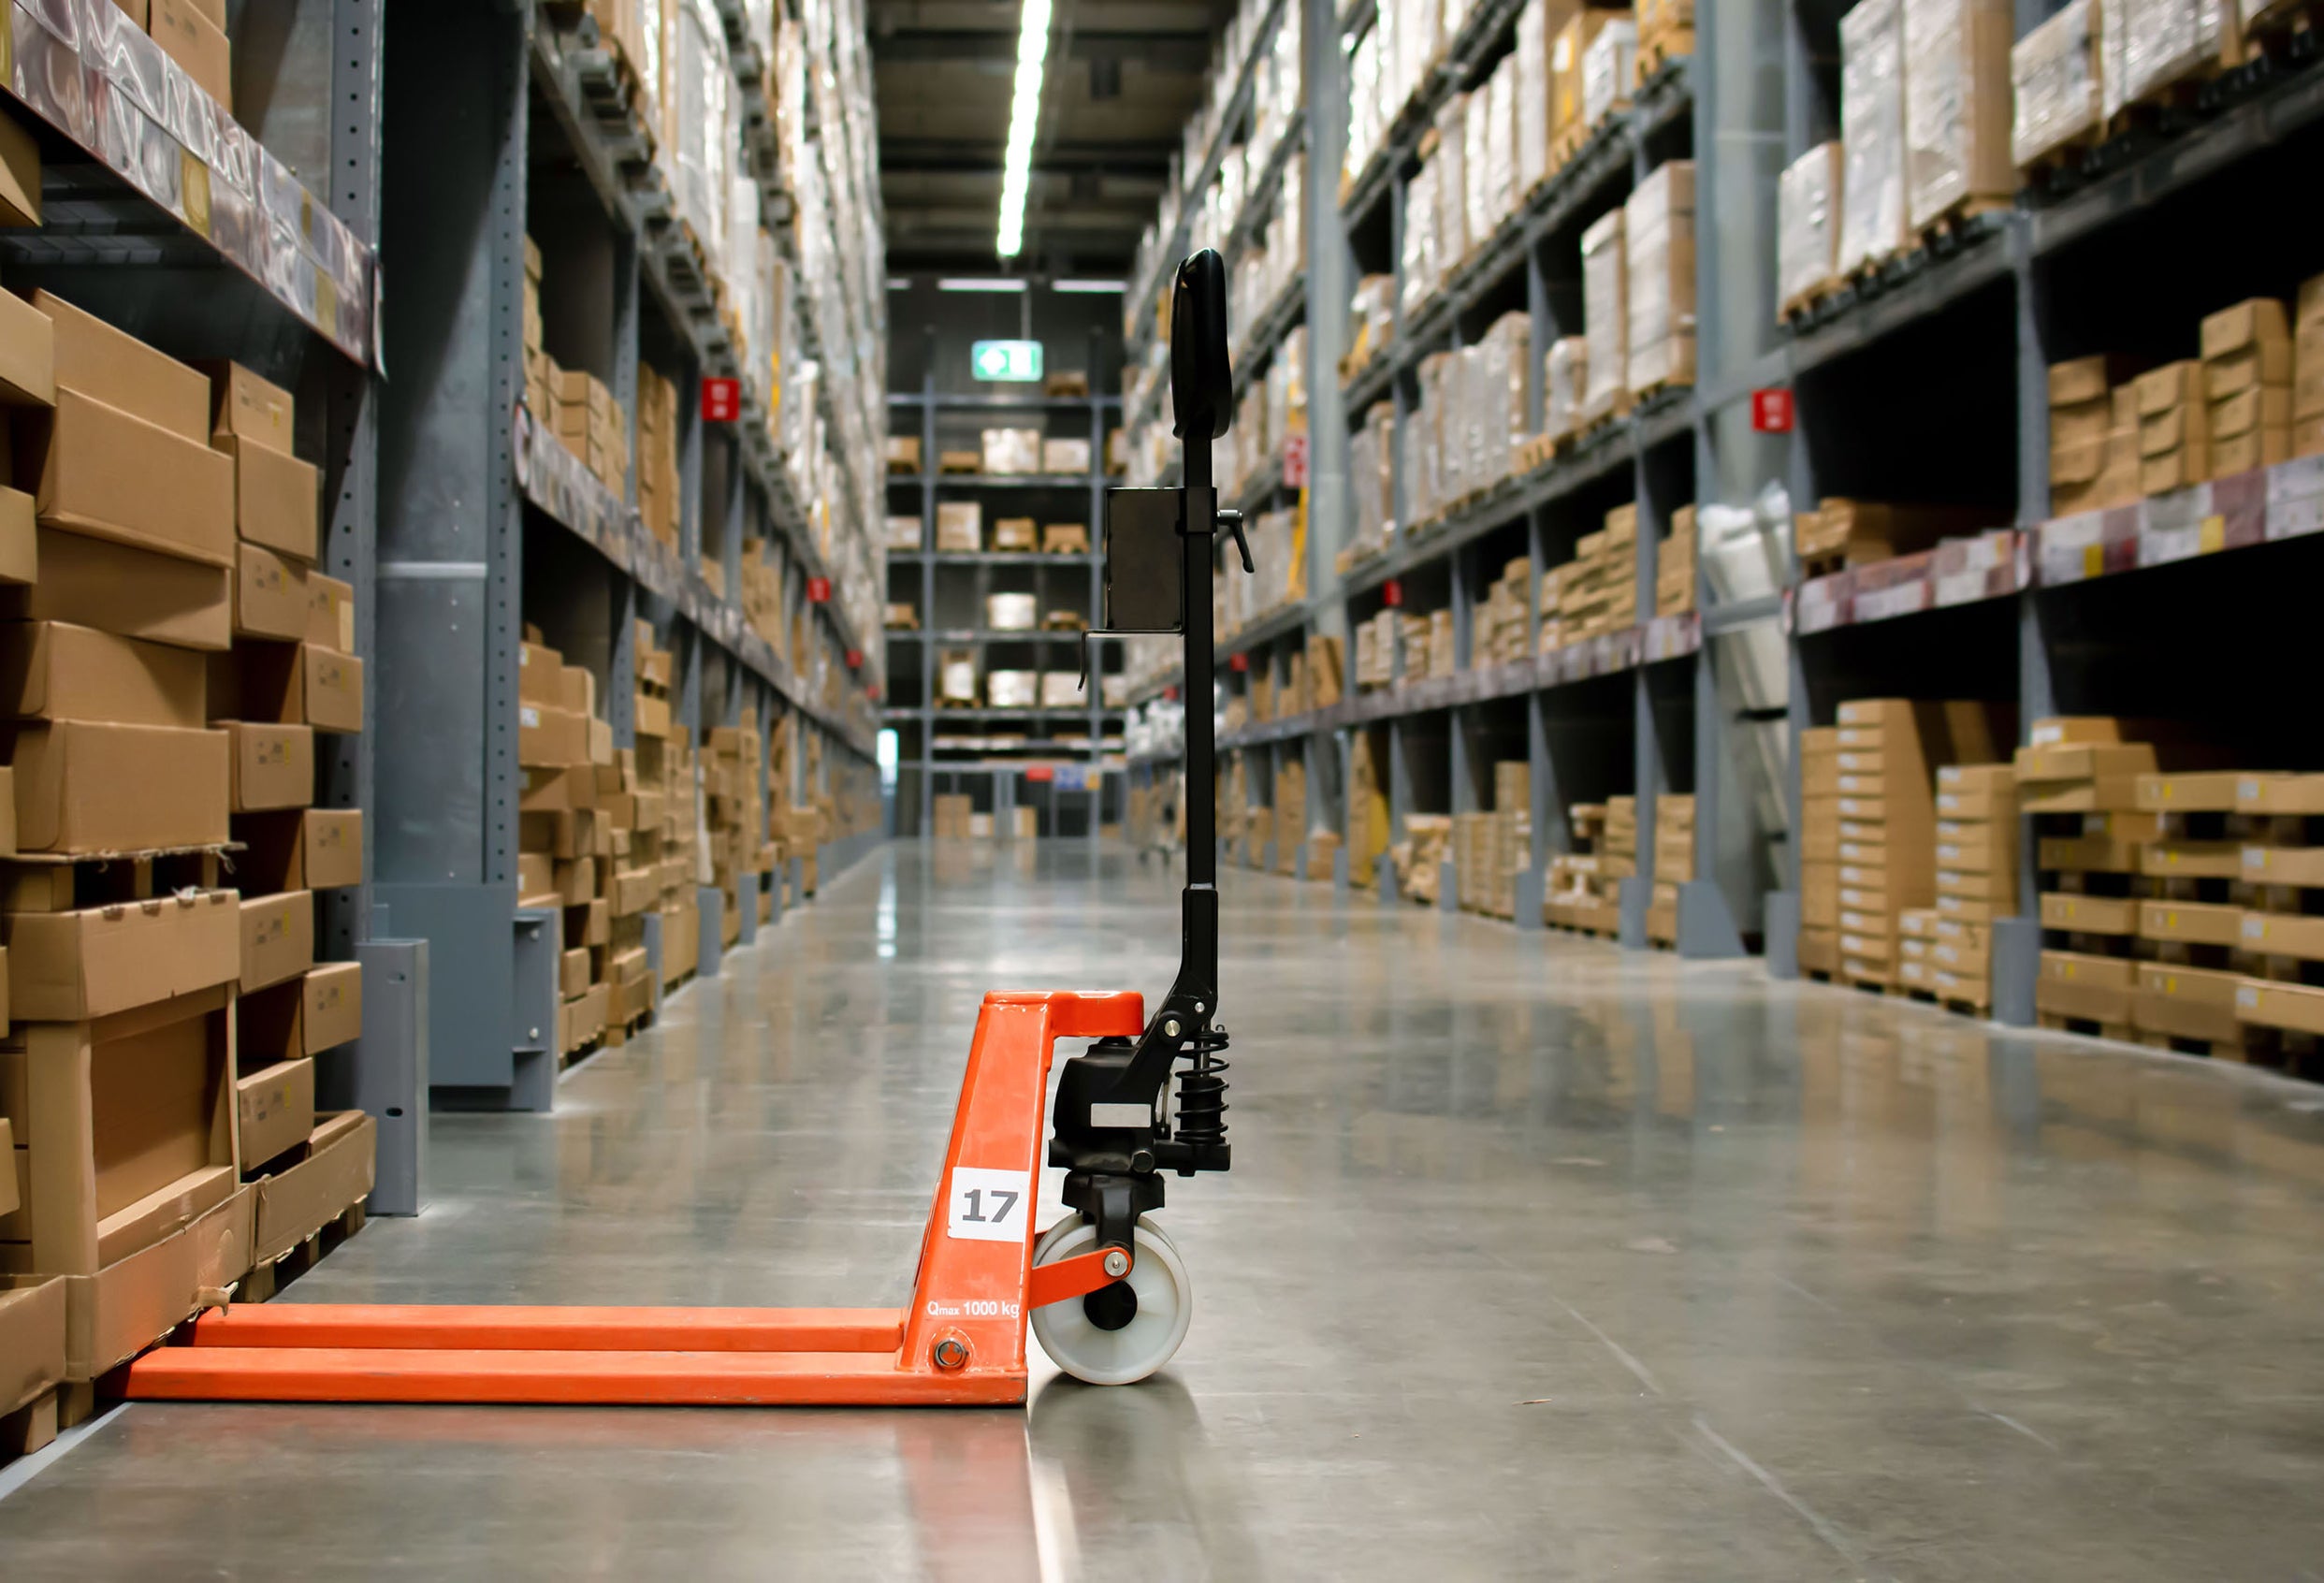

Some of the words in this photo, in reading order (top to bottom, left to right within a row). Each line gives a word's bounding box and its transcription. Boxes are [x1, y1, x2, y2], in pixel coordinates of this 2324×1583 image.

[963, 1189, 1018, 1223] 17
[927, 1300, 960, 1316] Qmax
[963, 1301, 997, 1315] 1000
[1001, 1301, 1020, 1318] kg
